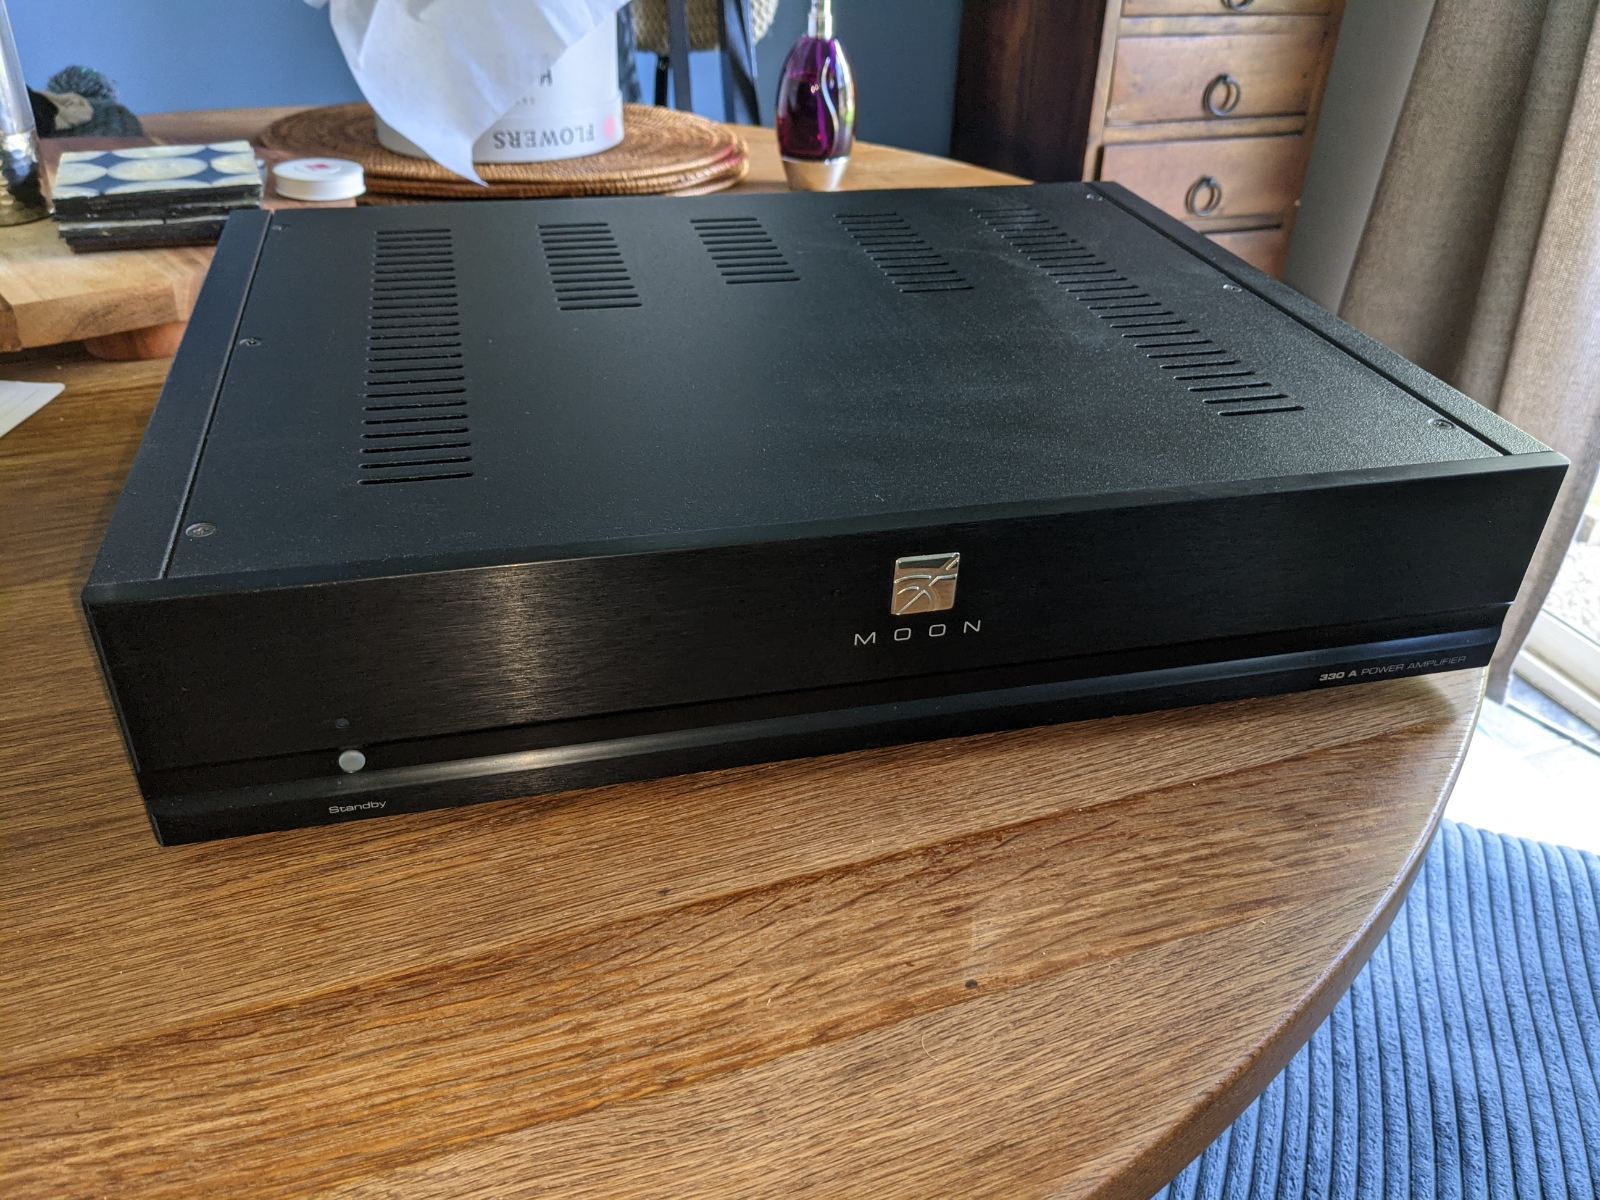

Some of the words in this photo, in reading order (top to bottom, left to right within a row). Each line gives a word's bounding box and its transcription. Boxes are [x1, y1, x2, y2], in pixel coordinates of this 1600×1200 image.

[493, 124, 595, 149] FLOWERS
[853, 619, 982, 646] MOON
[1319, 671, 1345, 682] 330
[1347, 669, 1357, 678] A
[1360, 663, 1405, 676] POWER
[1405, 655, 1467, 670] AMPLIFIER
[328, 800, 387, 814] Standby
